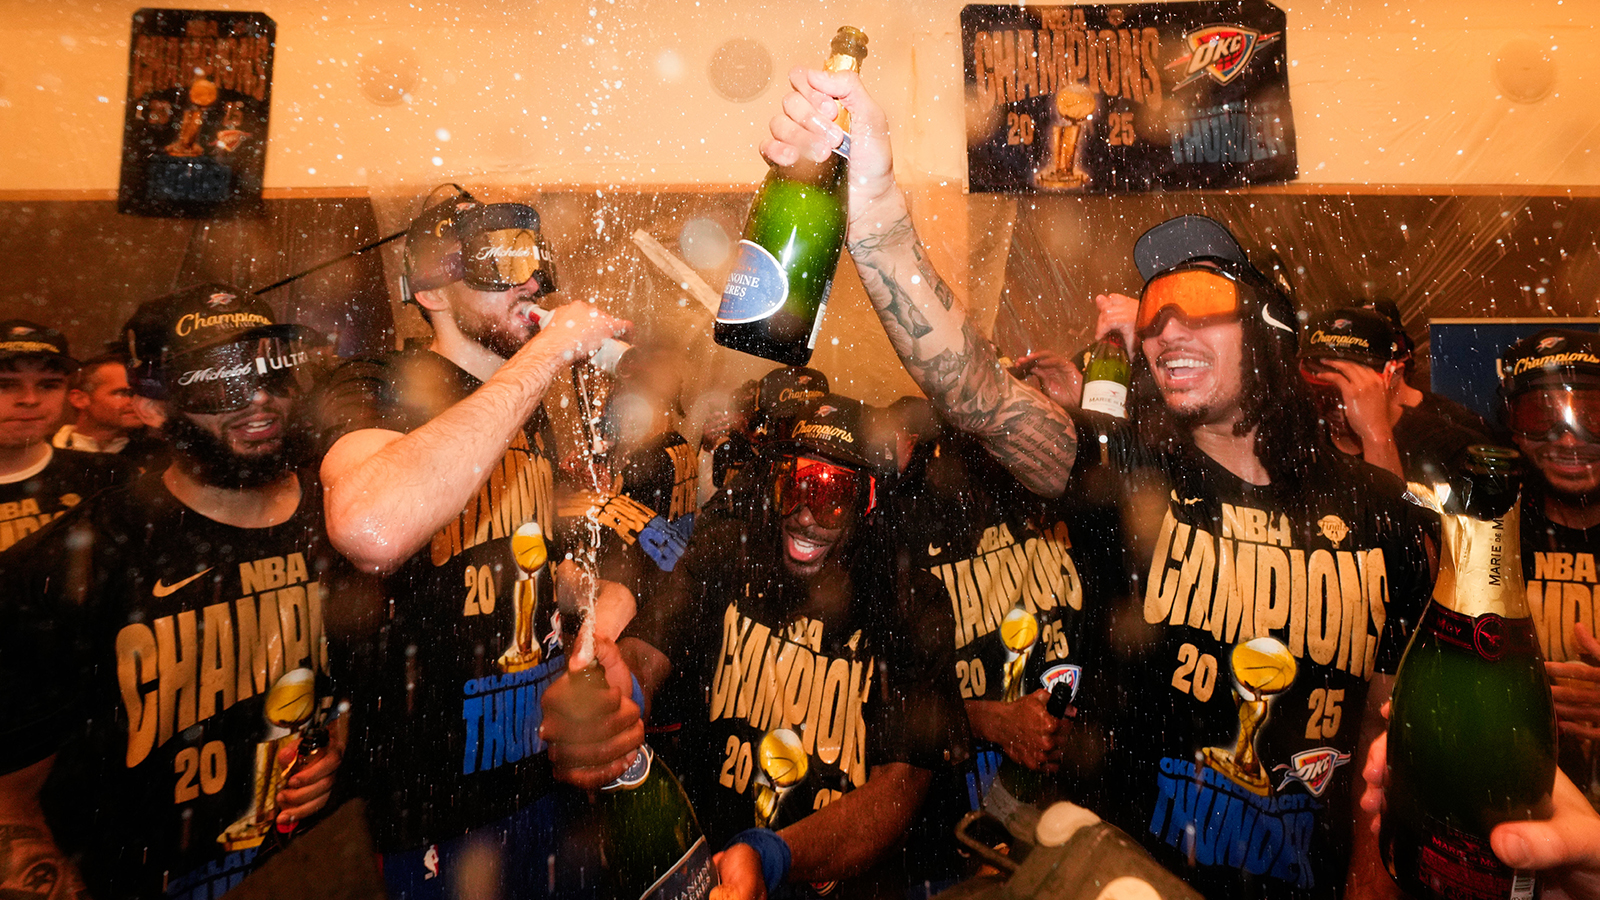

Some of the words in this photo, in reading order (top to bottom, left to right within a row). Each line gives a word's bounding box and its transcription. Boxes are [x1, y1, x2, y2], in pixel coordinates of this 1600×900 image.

[974, 27, 1162, 114] CHAMPIONS
[1187, 35, 1243, 74] OKC
[1007, 111, 1034, 146] 20
[1108, 112, 1135, 146] 25
[1310, 330, 1370, 348] Champions
[178, 361, 253, 386] Michelob
[1514, 352, 1600, 376] Champions
[791, 420, 854, 443] Champions
[1222, 502, 1292, 547] NBA
[239, 552, 309, 595] NBA
[1489, 545, 1502, 586] MARIE
[1534, 552, 1598, 583] NBA
[463, 565, 496, 616] 20
[1144, 503, 1390, 682] CHAMPIONS
[115, 582, 331, 768] CHAMPI
[955, 657, 987, 699] 20
[1042, 618, 1070, 662] 25
[1171, 643, 1218, 702] 20
[1304, 688, 1345, 740] 25
[174, 740, 228, 804] 20
[719, 734, 753, 795] 20
[1298, 756, 1330, 781] OKC
[1149, 771, 1316, 890] THUNDER
